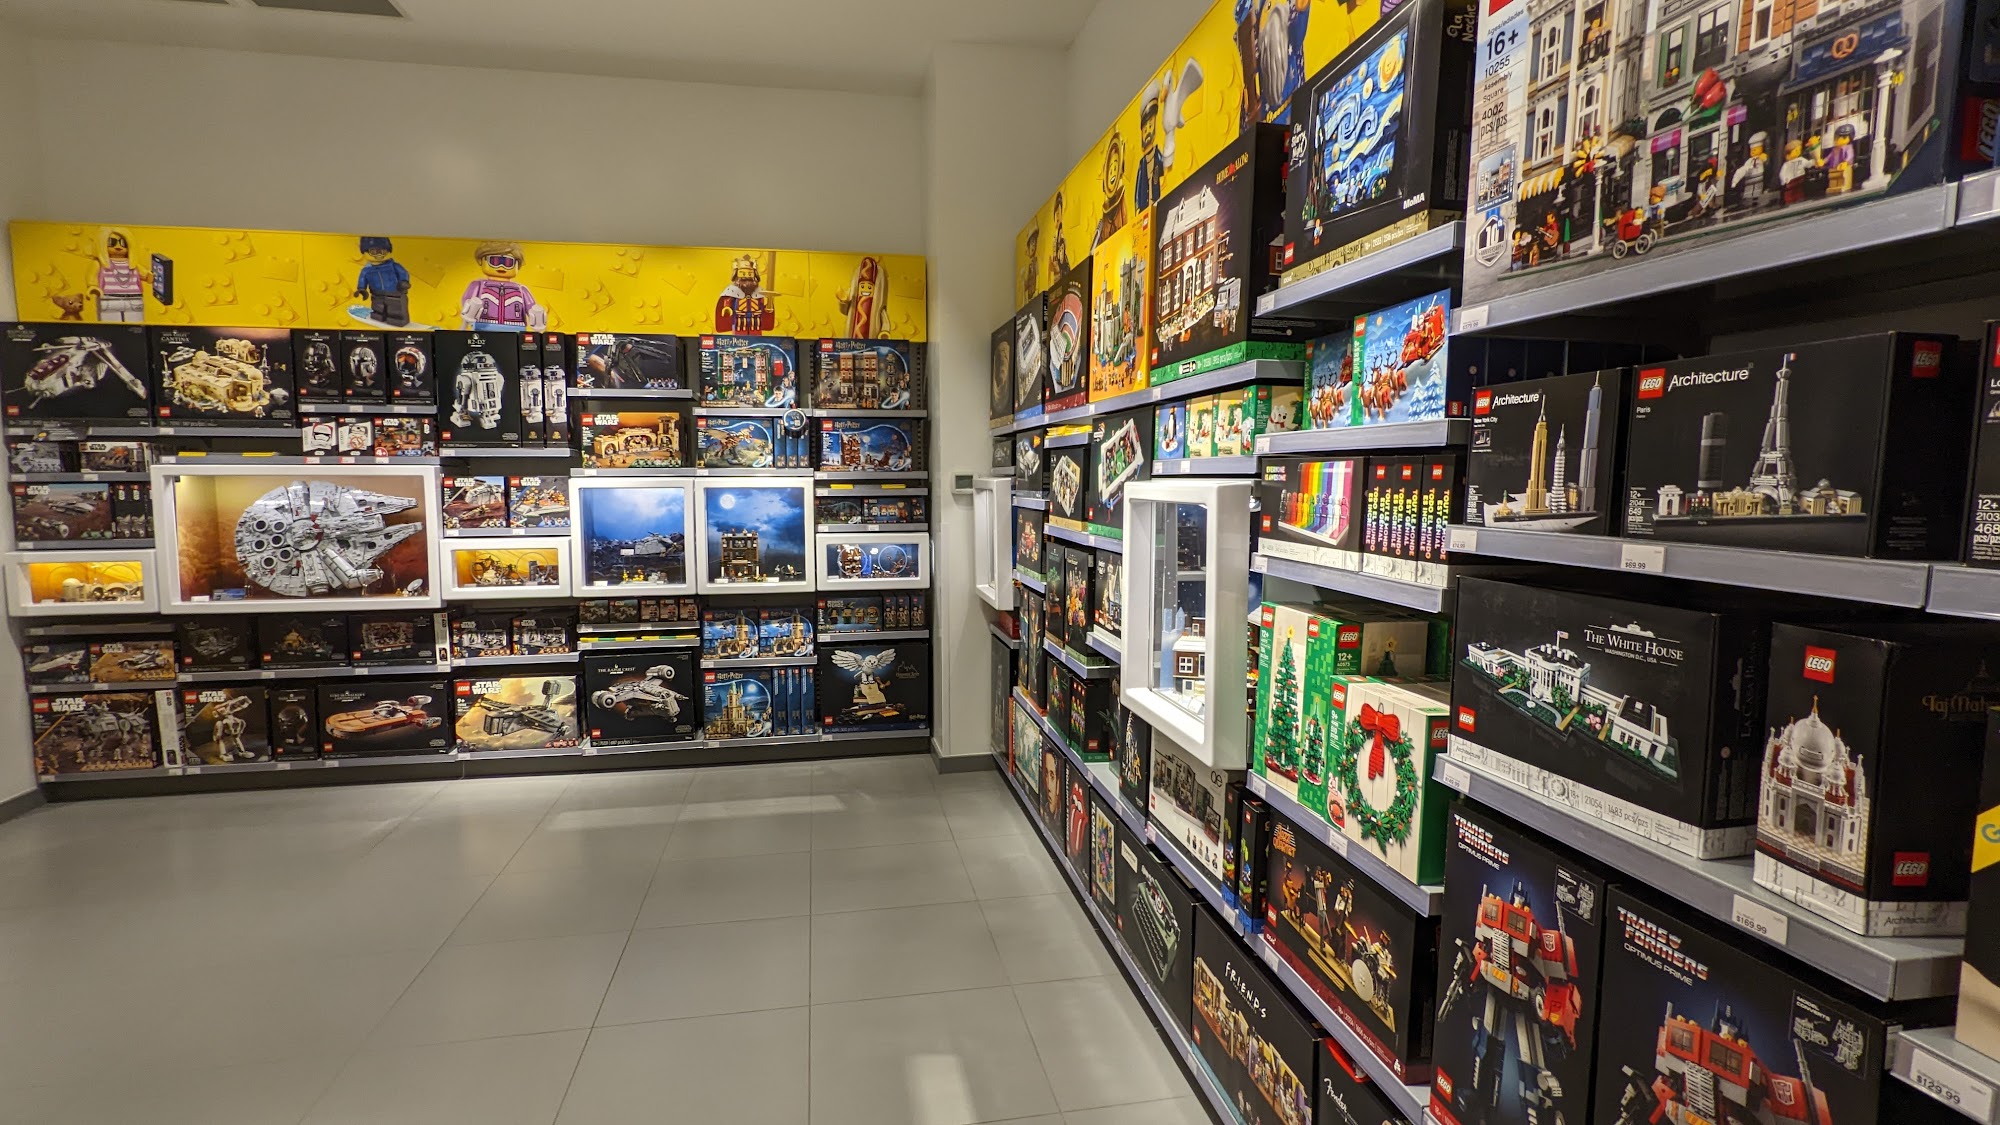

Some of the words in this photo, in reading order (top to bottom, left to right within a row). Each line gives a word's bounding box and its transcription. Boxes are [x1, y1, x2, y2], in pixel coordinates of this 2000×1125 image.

[1462, 4, 1476, 42] Noche
[1486, 29, 1519, 61] 16+
[1485, 55, 1511, 79] 10255
[1483, 70, 1513, 92] Assembly
[1482, 87, 1504, 103] Square
[1481, 102, 1504, 121] 4002
[1480, 114, 1508, 140] pcs/pzs
[1403, 192, 1425, 210] MoMA
[1486, 223, 1499, 247] 10
[731, 337, 749, 346] Potter
[1916, 352, 1939, 368] LEGO
[1641, 377, 1663, 391] LEGO
[1667, 369, 1750, 392] Architecture
[1475, 398, 1491, 408] LEGO
[1492, 392, 1540, 410] Architecture
[1490, 416, 1498, 425] City
[1630, 490, 1641, 498] 12+
[1628, 507, 1642, 515] 649
[1978, 499, 1998, 510] 12+
[1974, 524, 2000, 535] 468
[1425, 526, 1433, 559] MUNDO
[1625, 561, 1646, 570] $69.99
[1340, 632, 1359, 643] LEGO
[1583, 629, 1605, 645] THE
[1607, 634, 1643, 653] WHITE
[1644, 641, 1684, 661] HOUSE
[1337, 653, 1353, 661] 12+
[1604, 648, 1635, 660] WASHINGTON
[1805, 655, 1833, 673] LEGO
[1333, 690, 1345, 703] LEGO
[52, 704, 86, 712] WARS
[1459, 712, 1474, 726] LEGO
[1432, 727, 1450, 740] LEG
[1455, 745, 1482, 761] Architecture
[1570, 789, 1579, 800] 18+
[1584, 795, 1603, 810] 21054
[1607, 804, 1623, 818] 1483
[1624, 813, 1649, 828] pcs/pzs
[1458, 828, 1510, 865] FORMERS
[1458, 842, 1482, 861] OPTIMUS
[1481, 855, 1501, 871] PRIME
[1896, 861, 1927, 877] LEGO
[1736, 914, 1767, 936] $169.99
[1624, 926, 1710, 982] FORMERS
[1623, 942, 1663, 970] OPTIMUS
[1663, 964, 1693, 987] PRIME
[1796, 996, 1820, 1011] MODEL
[1796, 1001, 1831, 1021] CONVERTS
[1437, 1074, 1452, 1095] LEGO
[1916, 1074, 1961, 1105] $129.99
[1323, 1078, 1348, 1113] Fender
